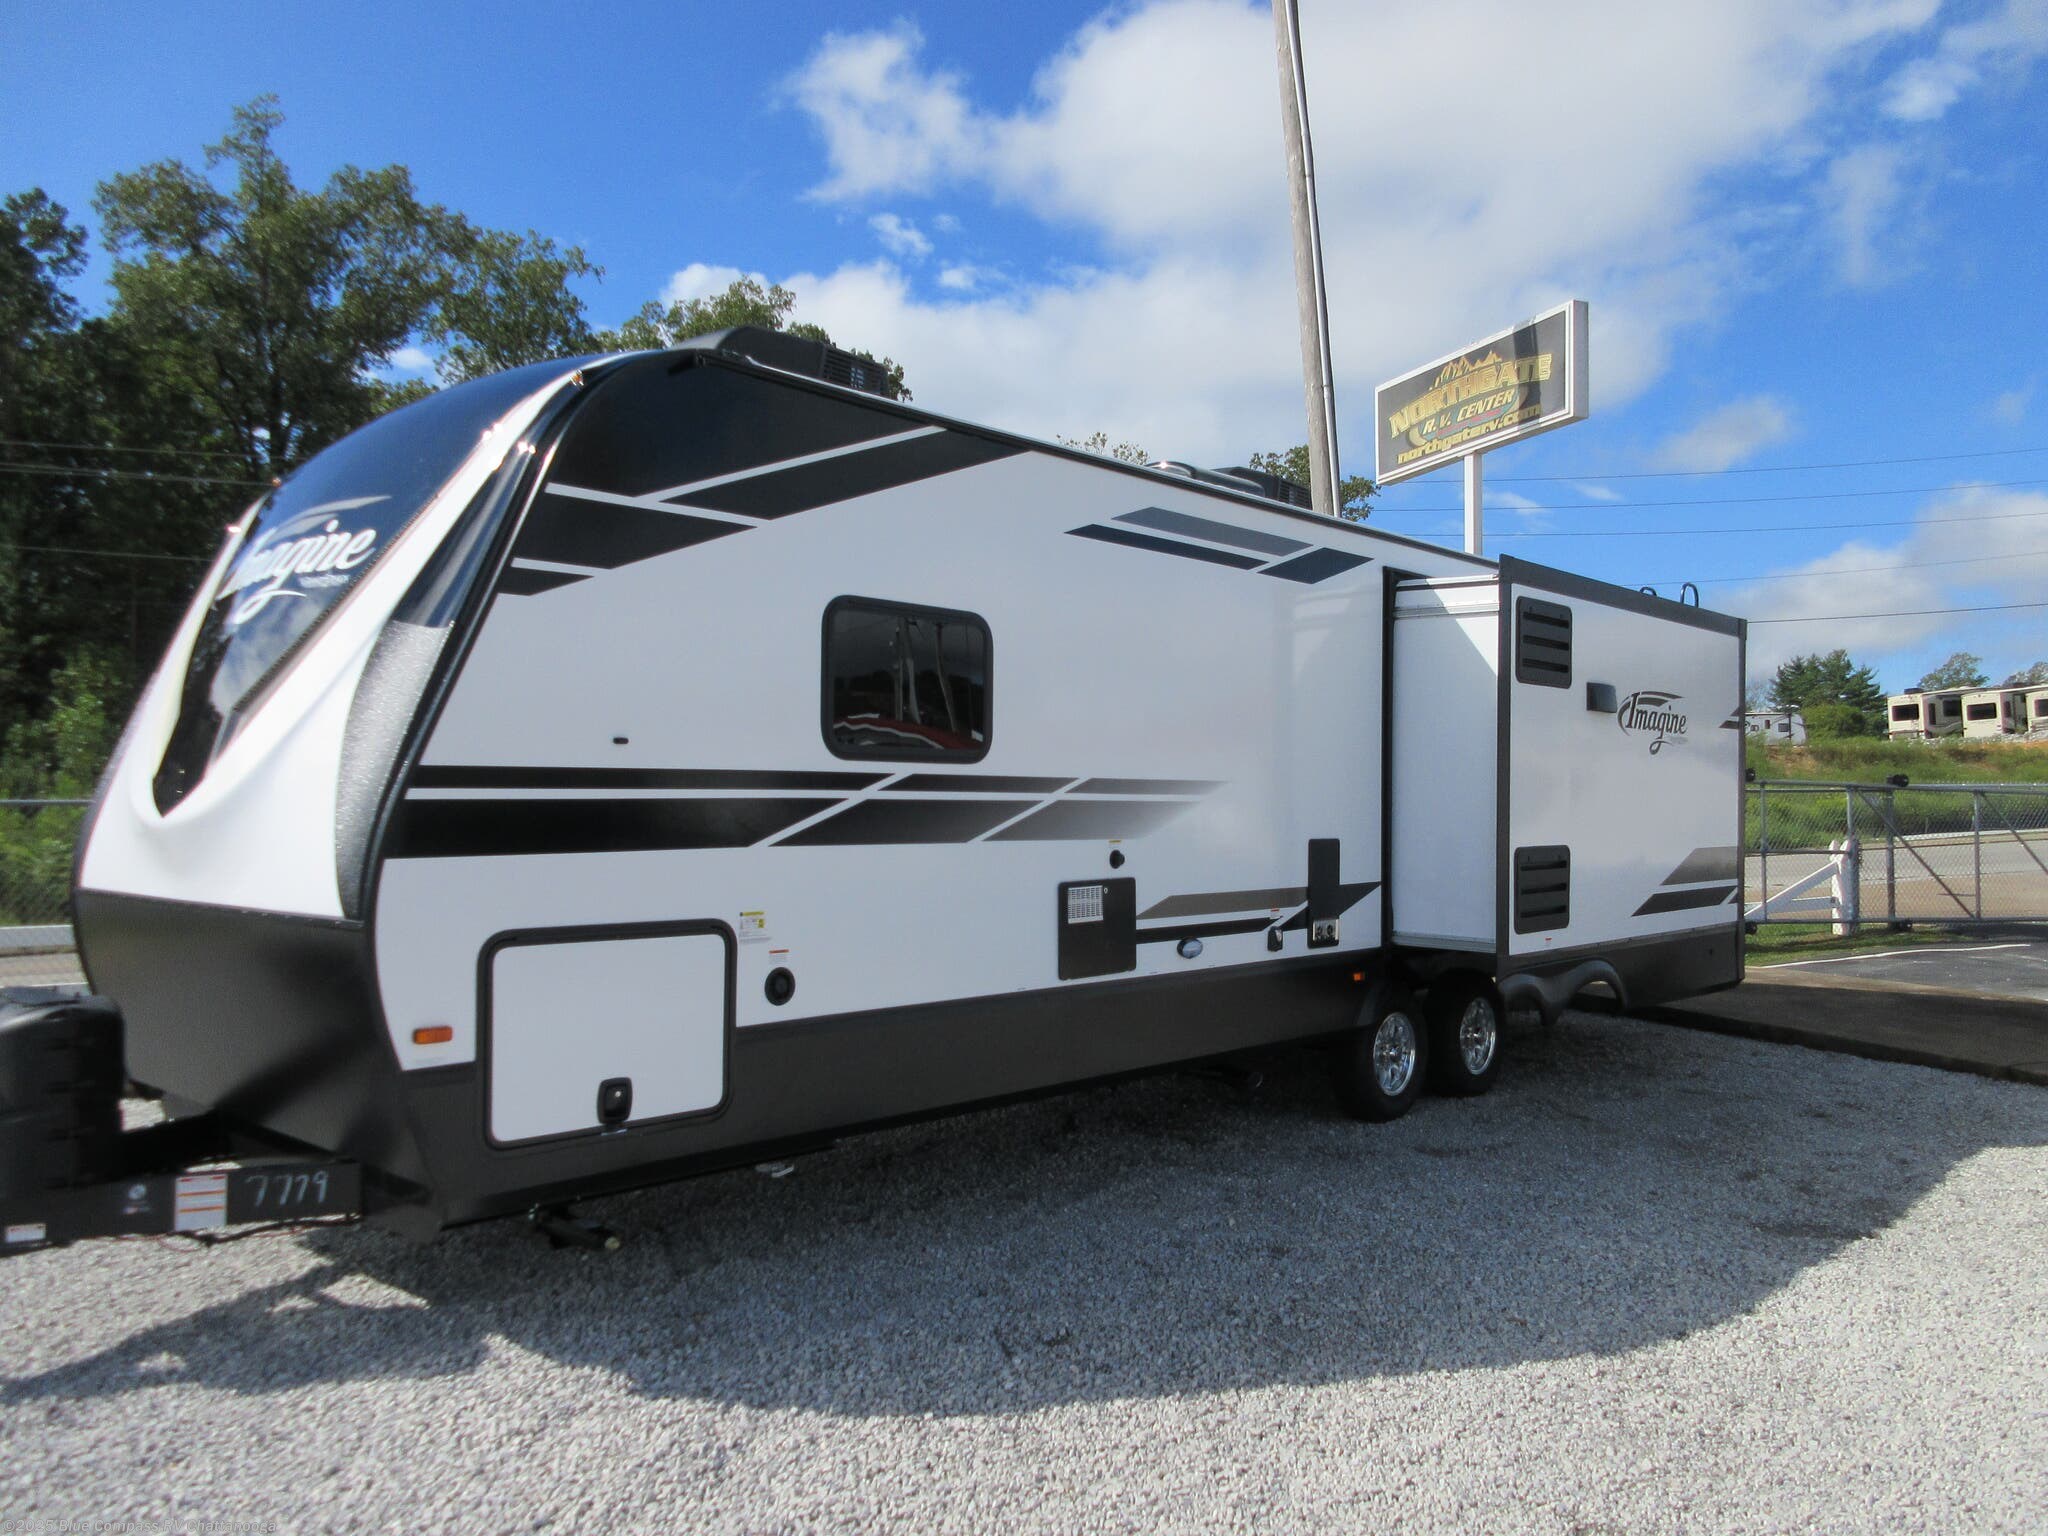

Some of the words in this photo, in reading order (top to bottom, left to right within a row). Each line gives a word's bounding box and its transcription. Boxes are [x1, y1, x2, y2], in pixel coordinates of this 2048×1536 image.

[1389, 353, 1552, 439] NORTHGATE
[1457, 389, 1515, 423] CENTER
[1625, 691, 1688, 755] Imagine
[245, 1172, 329, 1206] 7779
